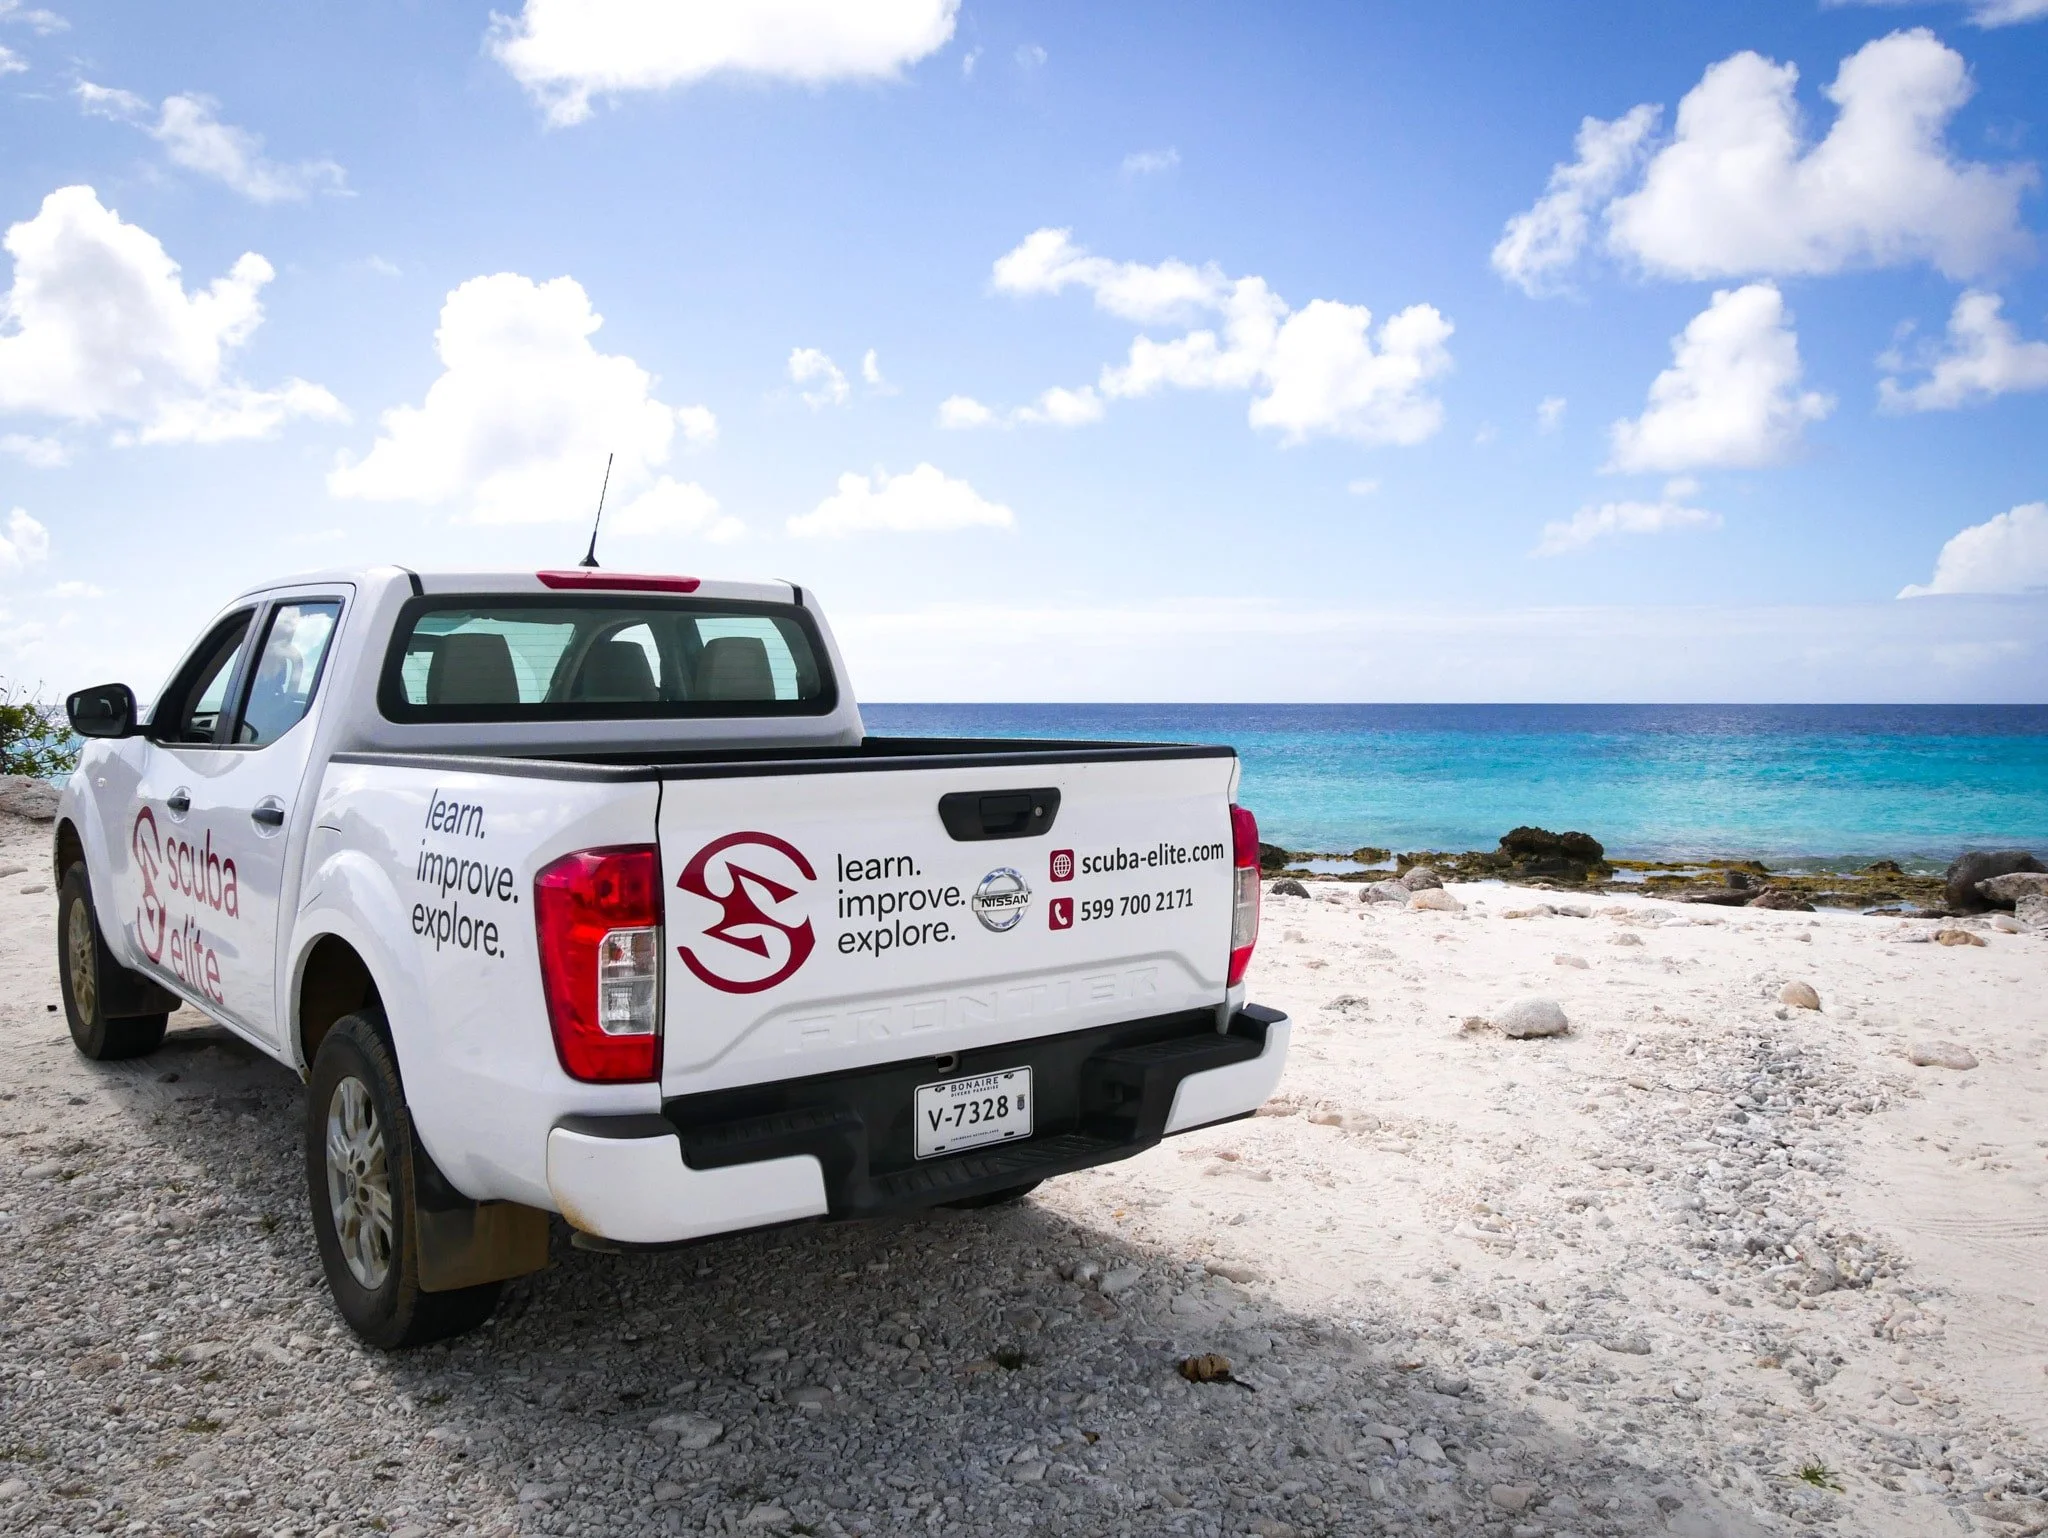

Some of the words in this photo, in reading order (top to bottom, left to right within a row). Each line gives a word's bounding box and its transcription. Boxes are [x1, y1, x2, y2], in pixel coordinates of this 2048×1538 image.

[426, 788, 485, 839] learn.
[167, 828, 239, 920] scuba
[417, 838, 519, 904] improve.
[837, 853, 921, 882] learn.
[1081, 842, 1224, 874] scuba-elite.com
[838, 885, 966, 922] improve.
[981, 894, 1029, 908] NISSAN
[1081, 898, 1114, 921] 599
[1120, 893, 1150, 916] 700
[1155, 888, 1193, 912] 2171
[412, 901, 505, 959] explore.
[838, 919, 956, 958] explore.
[171, 913, 224, 1005] elite
[786, 966, 1159, 1052] FRONTIER
[951, 1076, 999, 1092] BONAIRE
[928, 1095, 1009, 1132] V-7328
